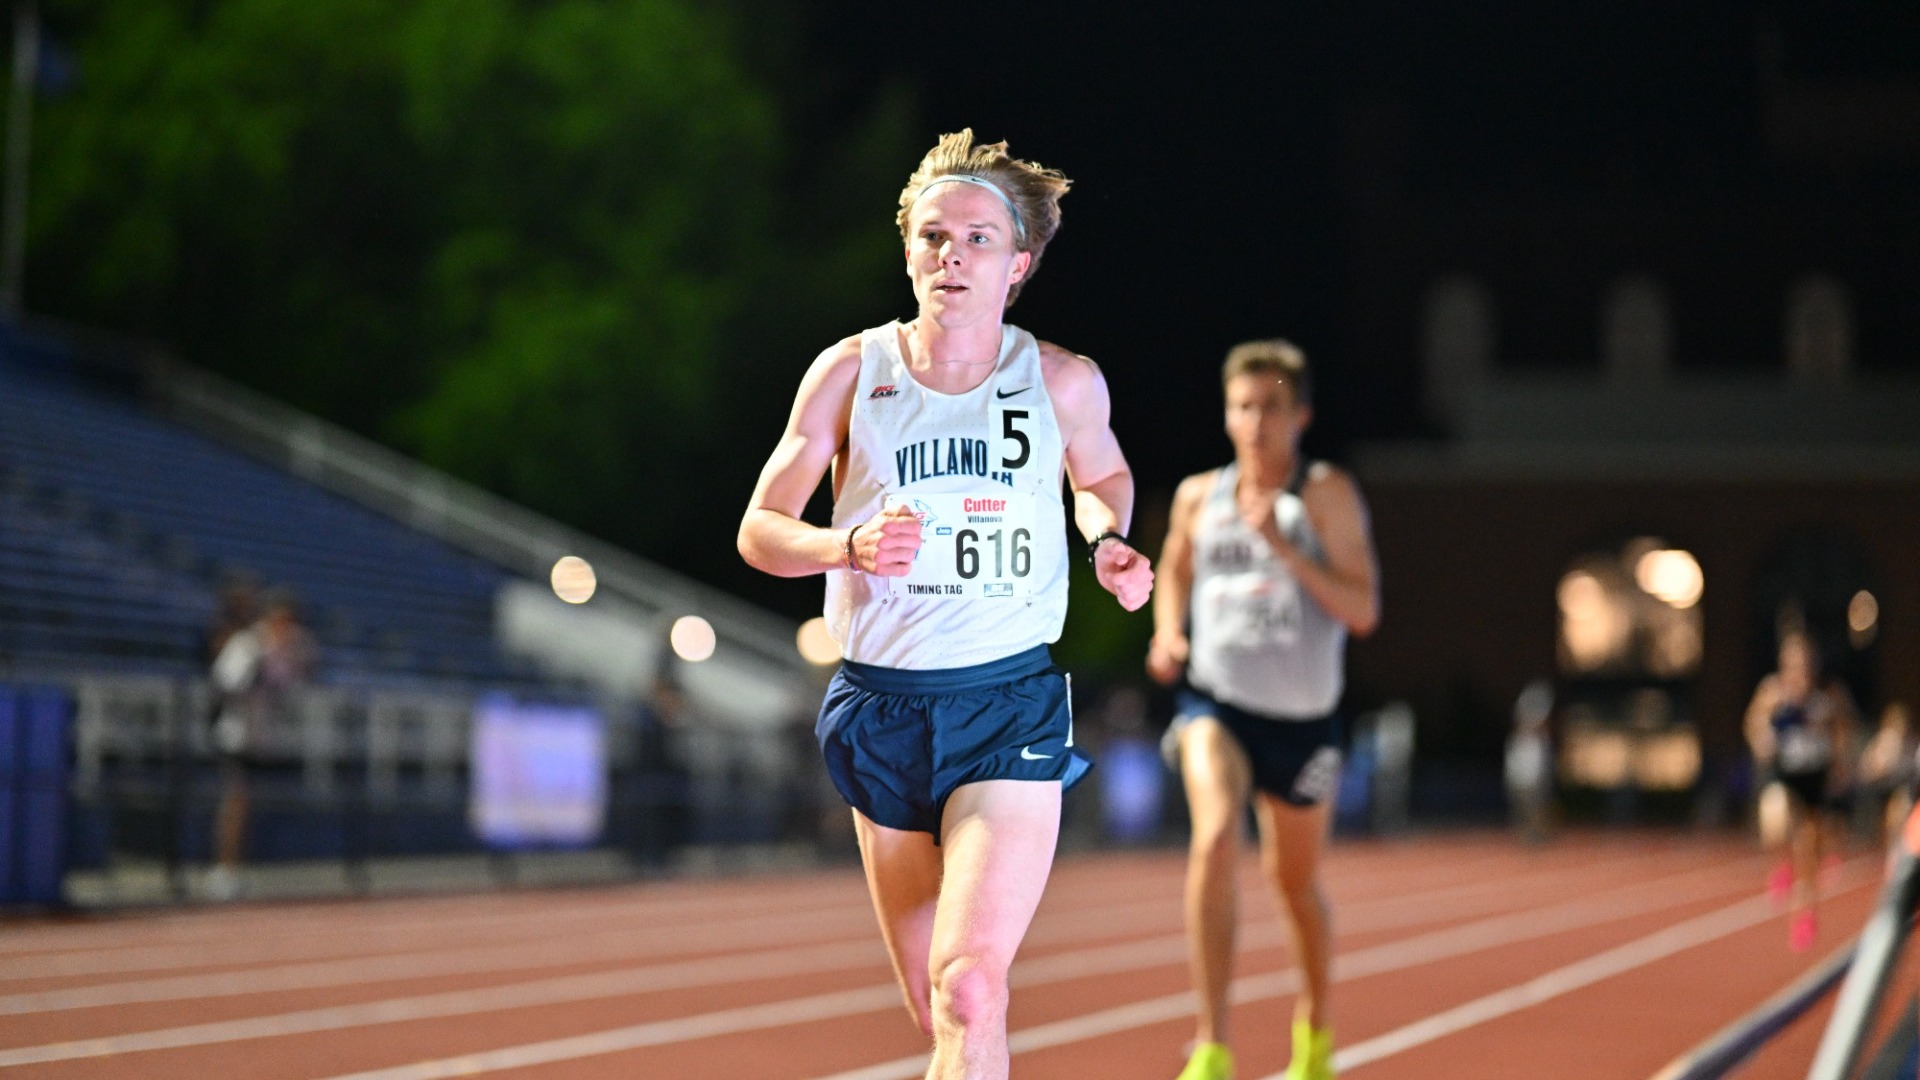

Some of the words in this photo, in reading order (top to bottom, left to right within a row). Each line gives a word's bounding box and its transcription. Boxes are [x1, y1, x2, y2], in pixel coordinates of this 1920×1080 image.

[869, 390, 900, 398] EAST
[1002, 409, 1031, 470] 5
[964, 498, 1007, 512] Cutter
[967, 515, 1003, 523] Villanova
[955, 528, 1031, 579] 616
[907, 584, 942, 594] TIMING
[944, 584, 963, 594] TAG
